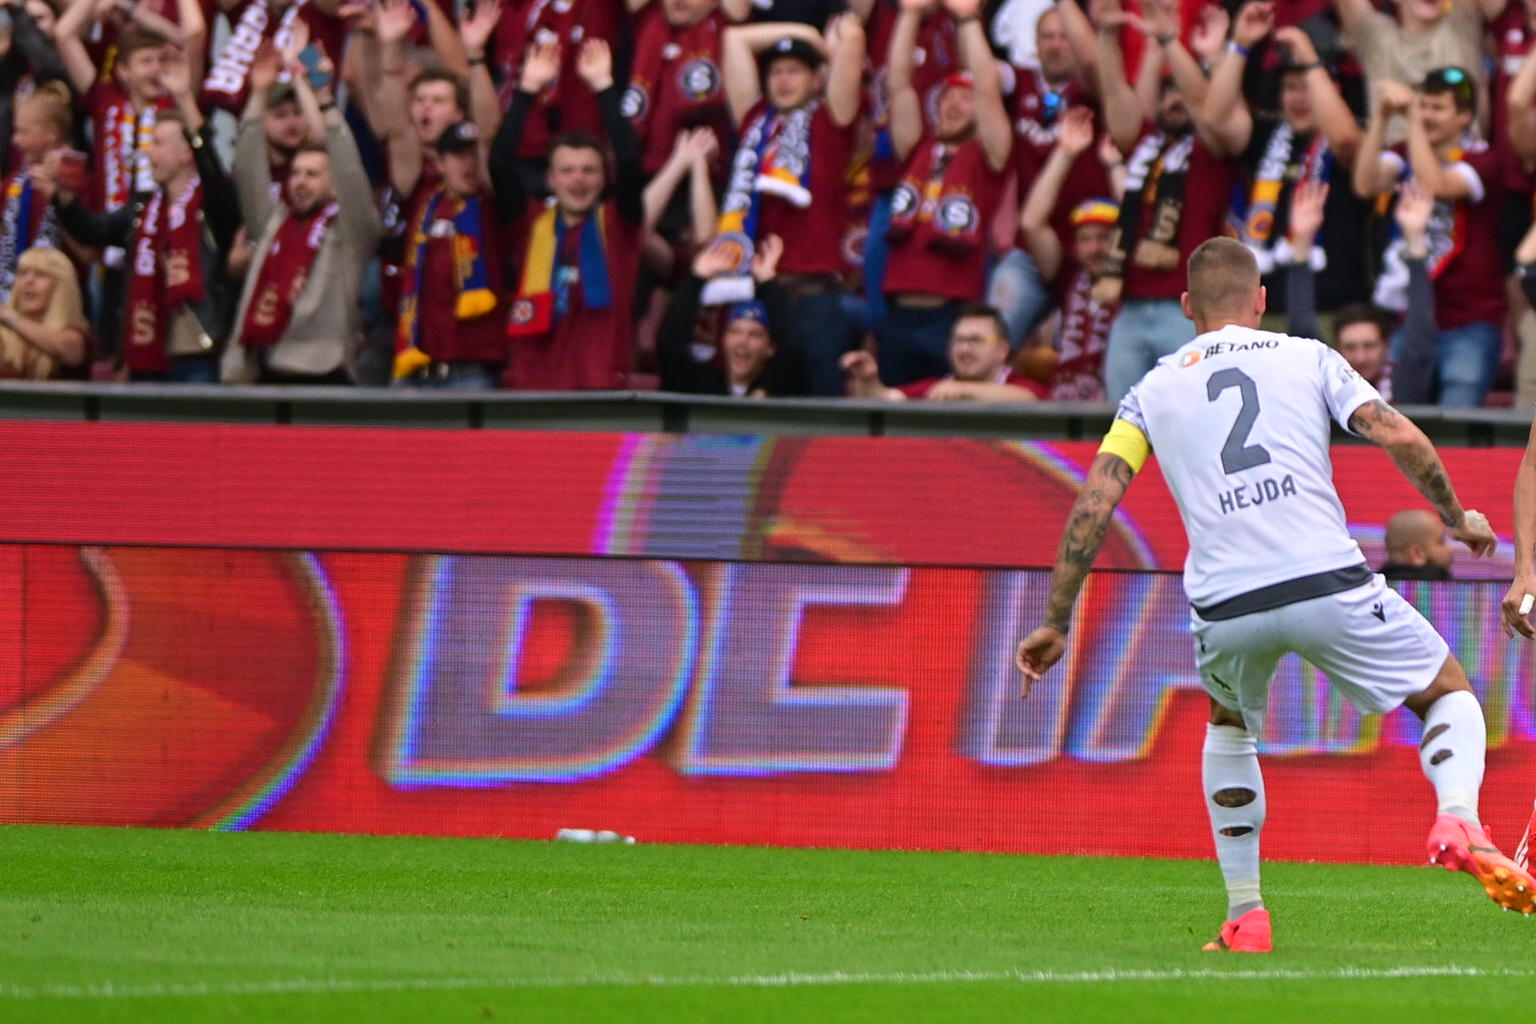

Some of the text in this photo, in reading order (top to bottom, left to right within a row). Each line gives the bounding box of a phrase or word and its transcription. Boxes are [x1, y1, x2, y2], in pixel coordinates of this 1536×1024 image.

[1203, 340, 1279, 359] BETANO
[1206, 367, 1271, 475] 2
[1219, 474, 1297, 516] HEJDA
